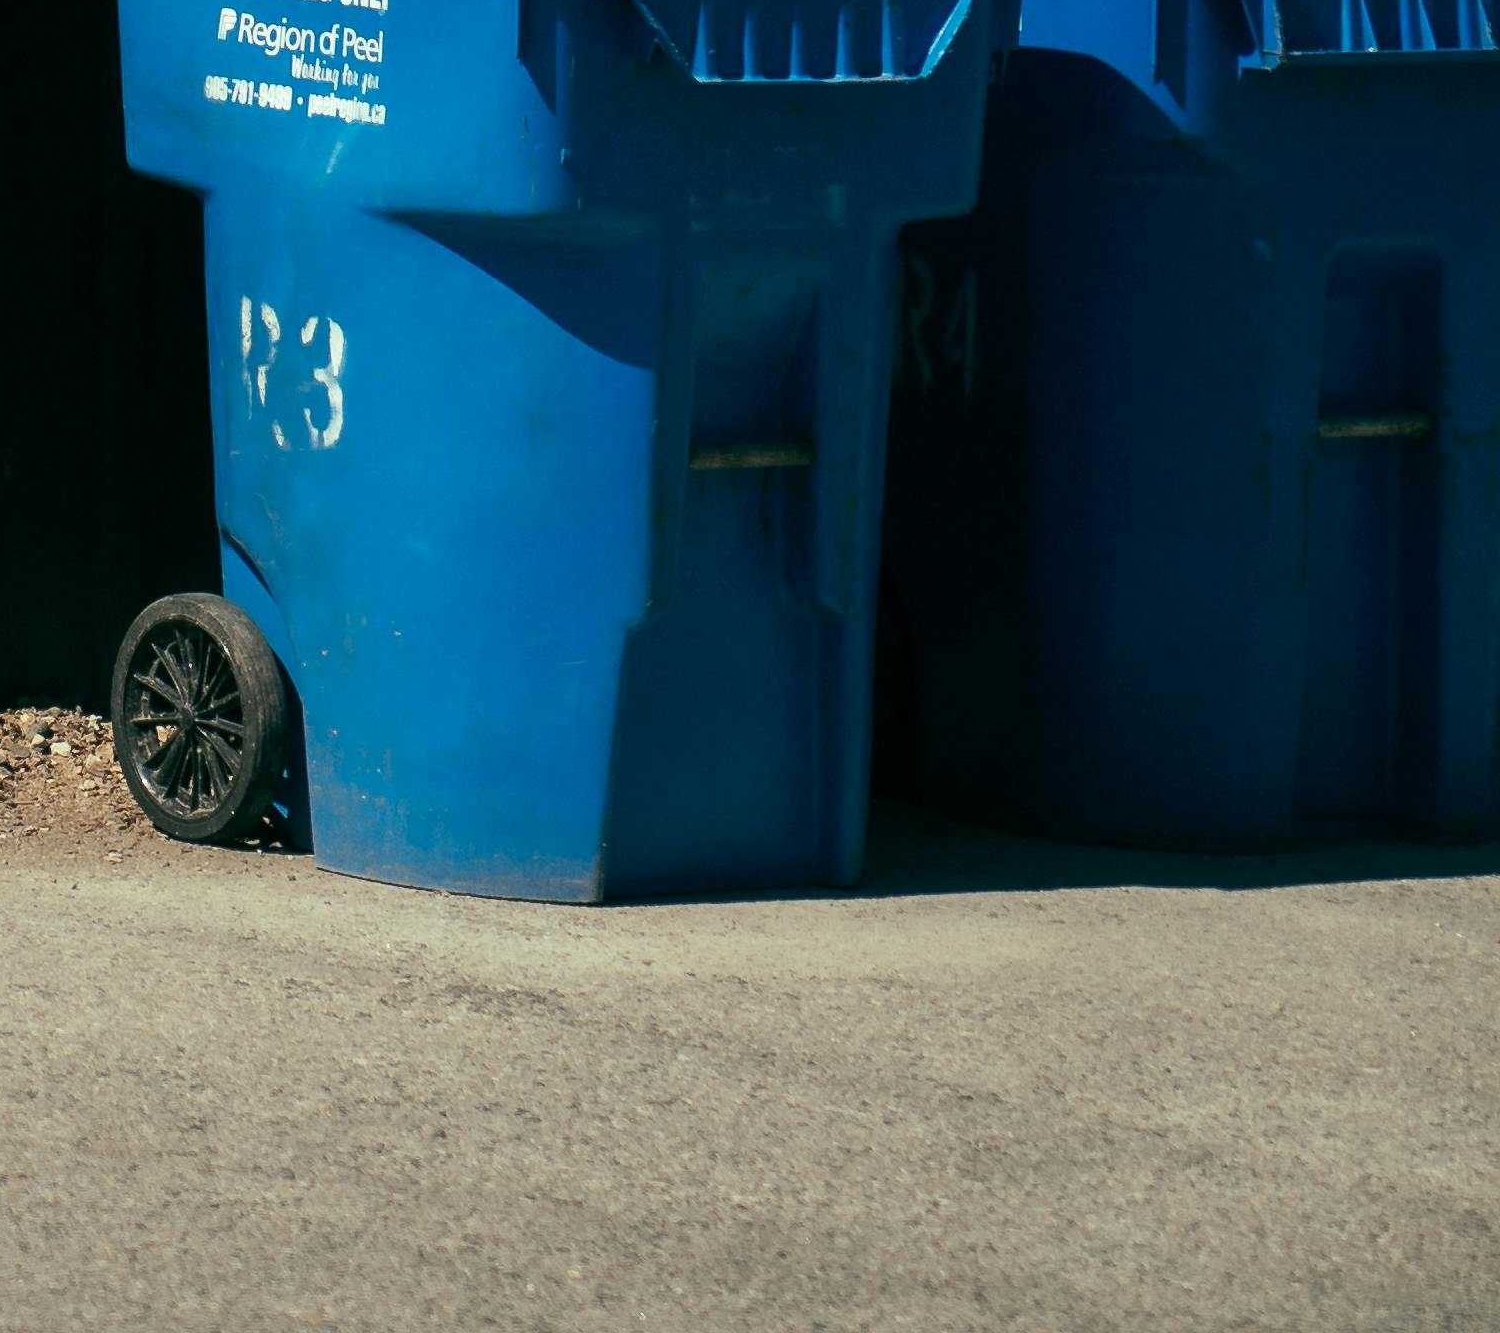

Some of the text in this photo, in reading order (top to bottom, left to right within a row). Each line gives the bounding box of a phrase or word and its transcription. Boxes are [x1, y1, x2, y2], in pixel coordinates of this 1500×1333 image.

[237, 12, 315, 56] Region
[319, 23, 340, 56] of
[342, 27, 384, 63] Peel
[290, 54, 339, 91] Working
[342, 62, 358, 87] for
[240, 295, 346, 449] R3
